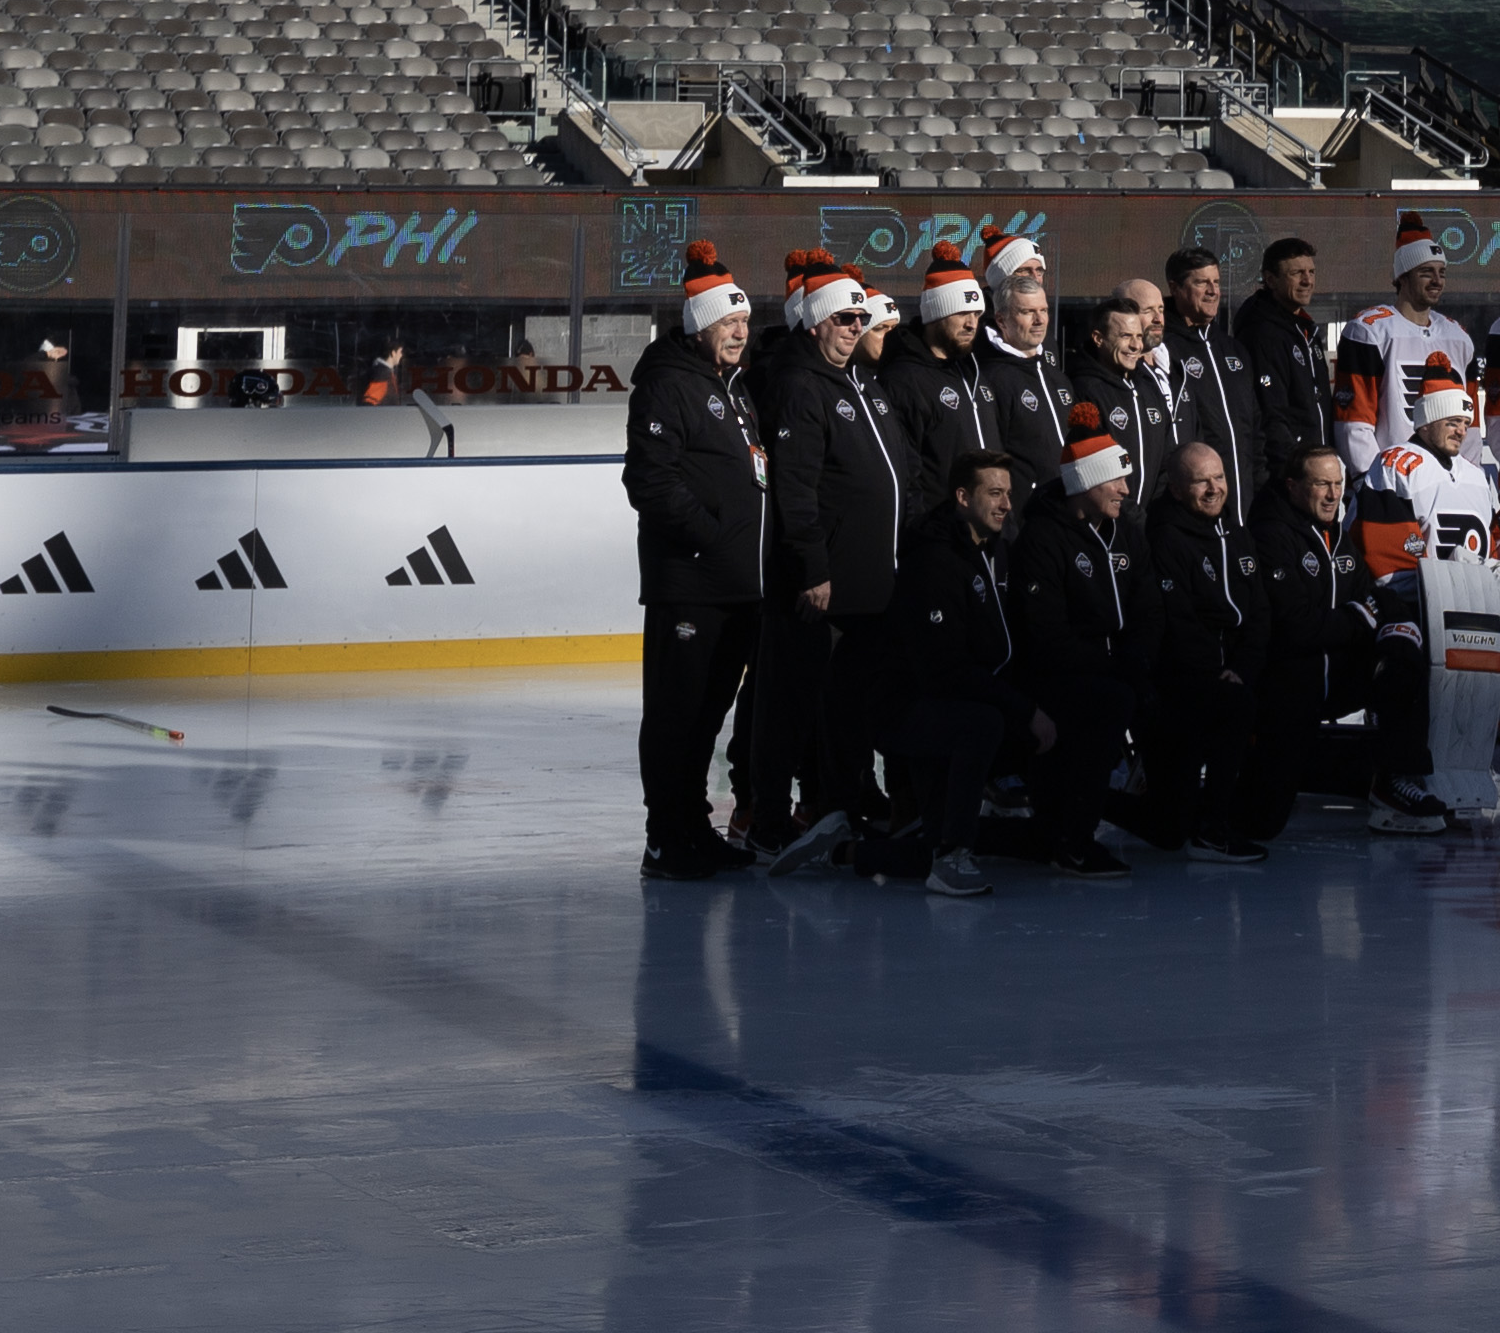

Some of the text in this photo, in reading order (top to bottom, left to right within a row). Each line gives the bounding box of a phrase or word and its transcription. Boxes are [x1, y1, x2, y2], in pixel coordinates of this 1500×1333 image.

[326, 207, 479, 268] PHI
[406, 365, 629, 396] HONDA
[0, 411, 62, 426] eams
[1380, 445, 1424, 477] 40
[1452, 632, 1497, 647] VAUGHN
